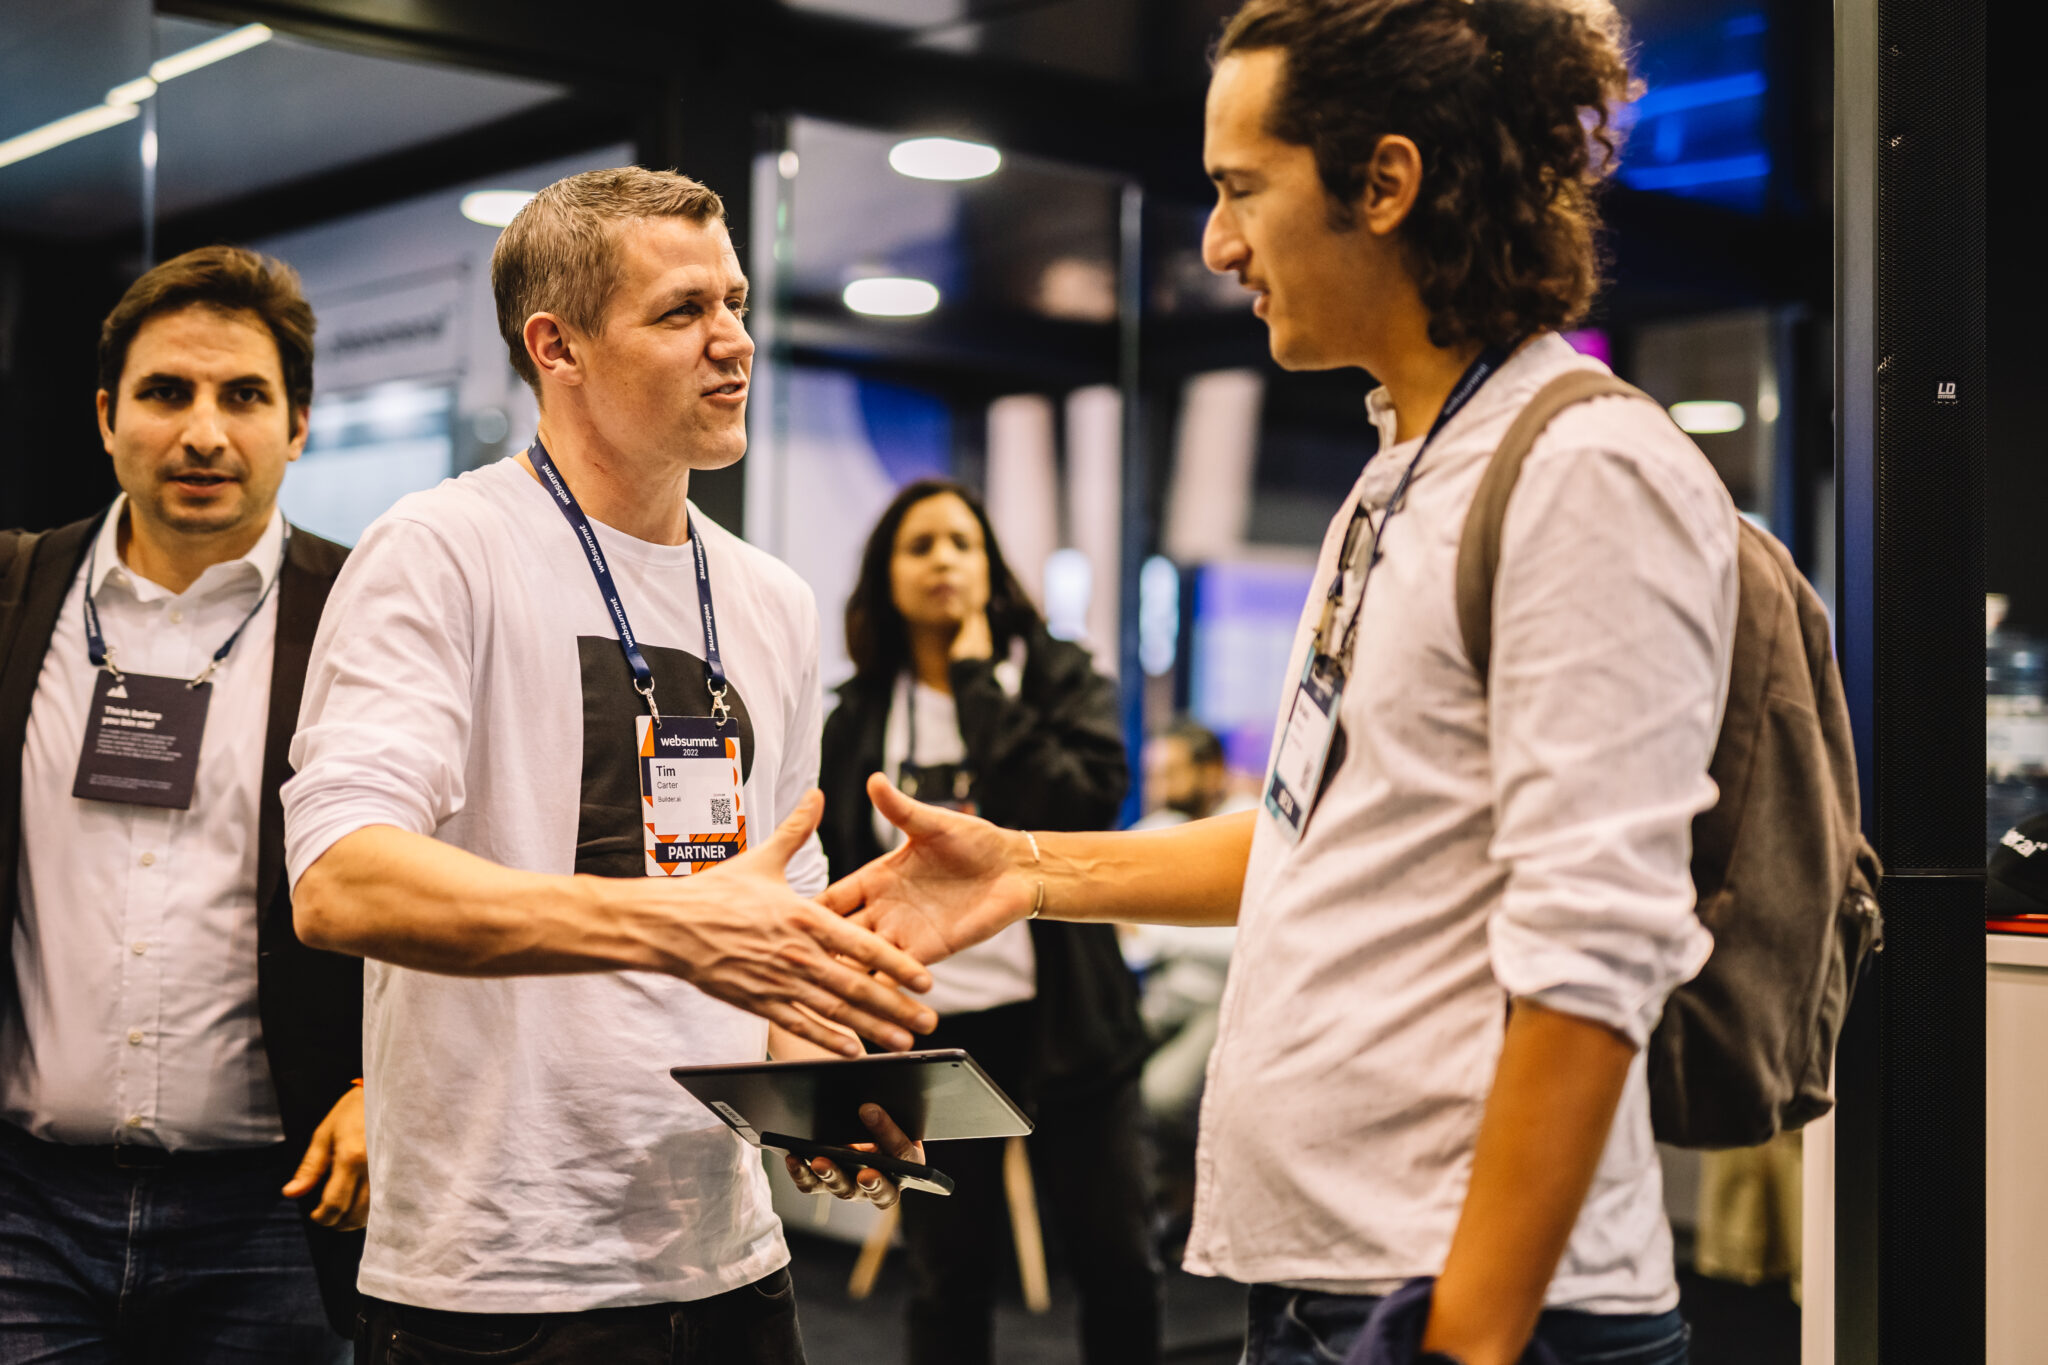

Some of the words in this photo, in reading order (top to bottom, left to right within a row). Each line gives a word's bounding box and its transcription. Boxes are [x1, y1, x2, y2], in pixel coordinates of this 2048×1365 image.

[1937, 382, 1956, 395] LD
[541, 463, 571, 506] websummit
[579, 524, 605, 573] websummit
[610, 596, 634, 648] websummit
[131, 709, 163, 721] before
[682, 748, 699, 757] 2022
[656, 765, 676, 777] Tim
[656, 781, 679, 789] Carter
[668, 844, 726, 860] PARTNER
